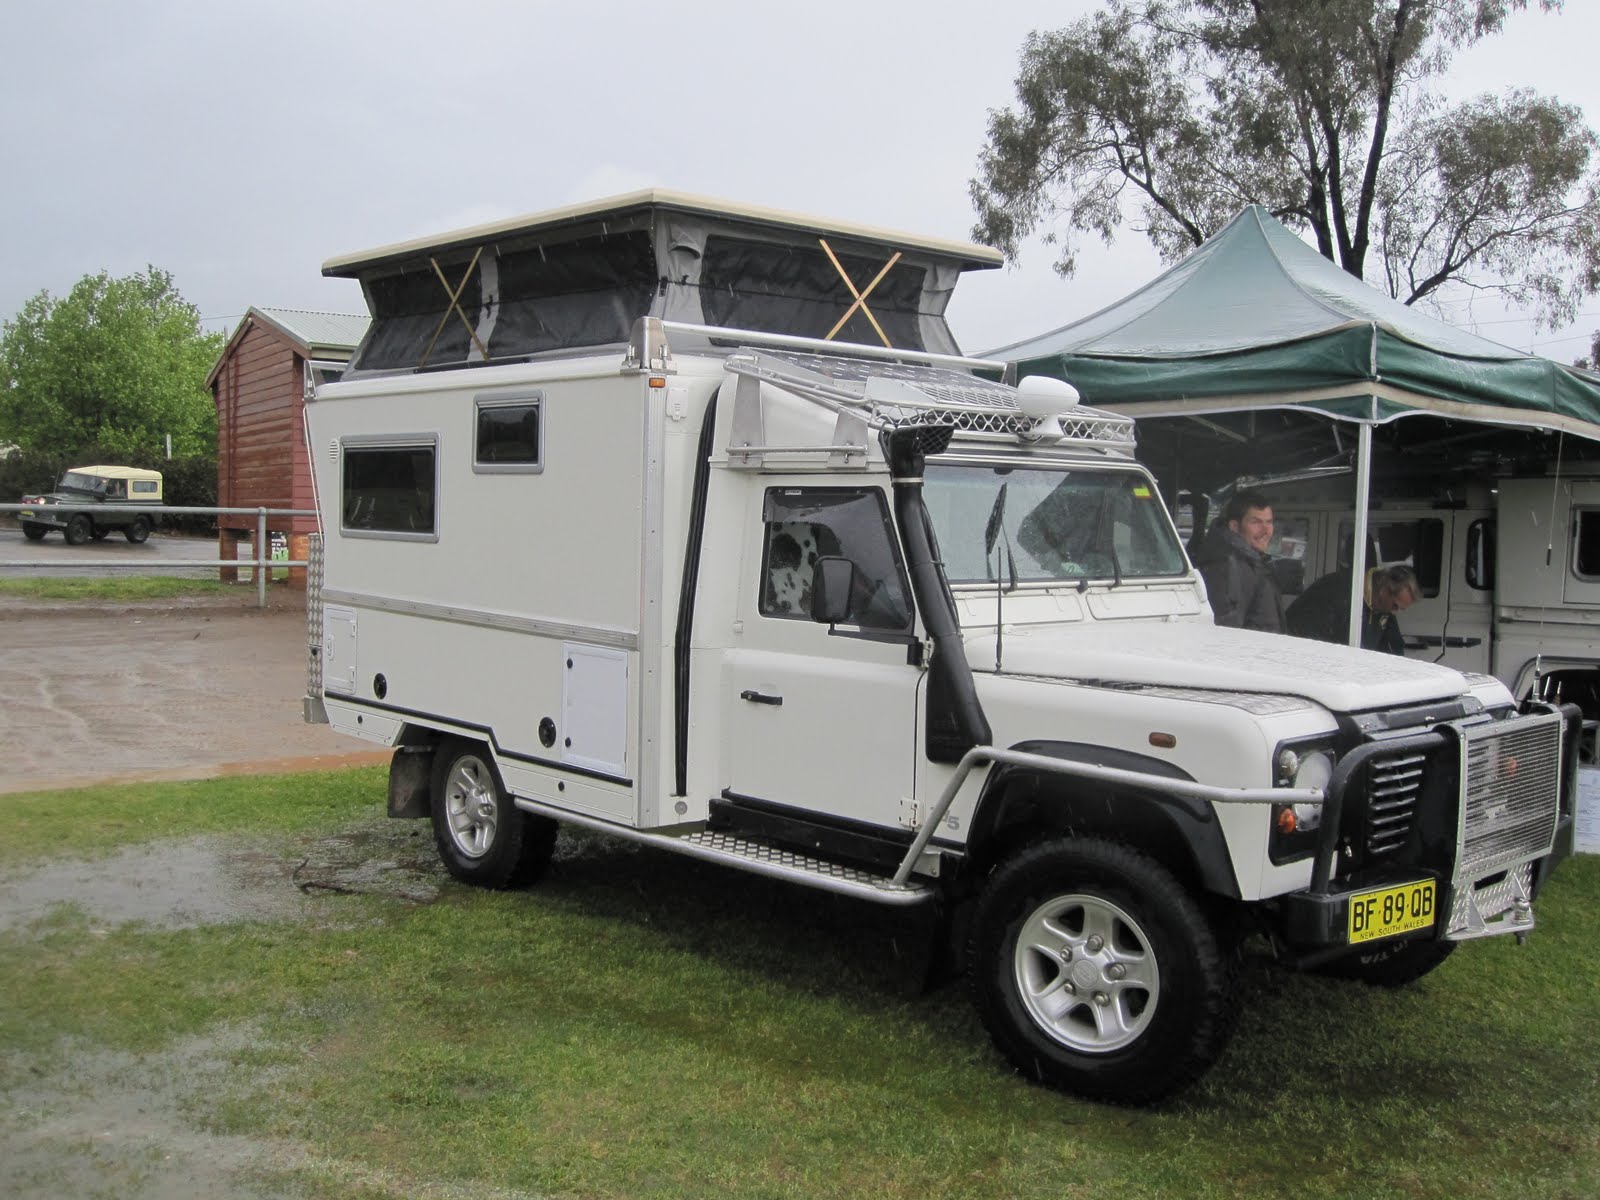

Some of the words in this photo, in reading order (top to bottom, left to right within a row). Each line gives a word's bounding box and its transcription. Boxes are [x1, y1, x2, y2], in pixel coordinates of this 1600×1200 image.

[1360, 930, 1375, 940] NEW
[1378, 925, 1400, 936] SOUTH
[1403, 919, 1425, 929] WALES
